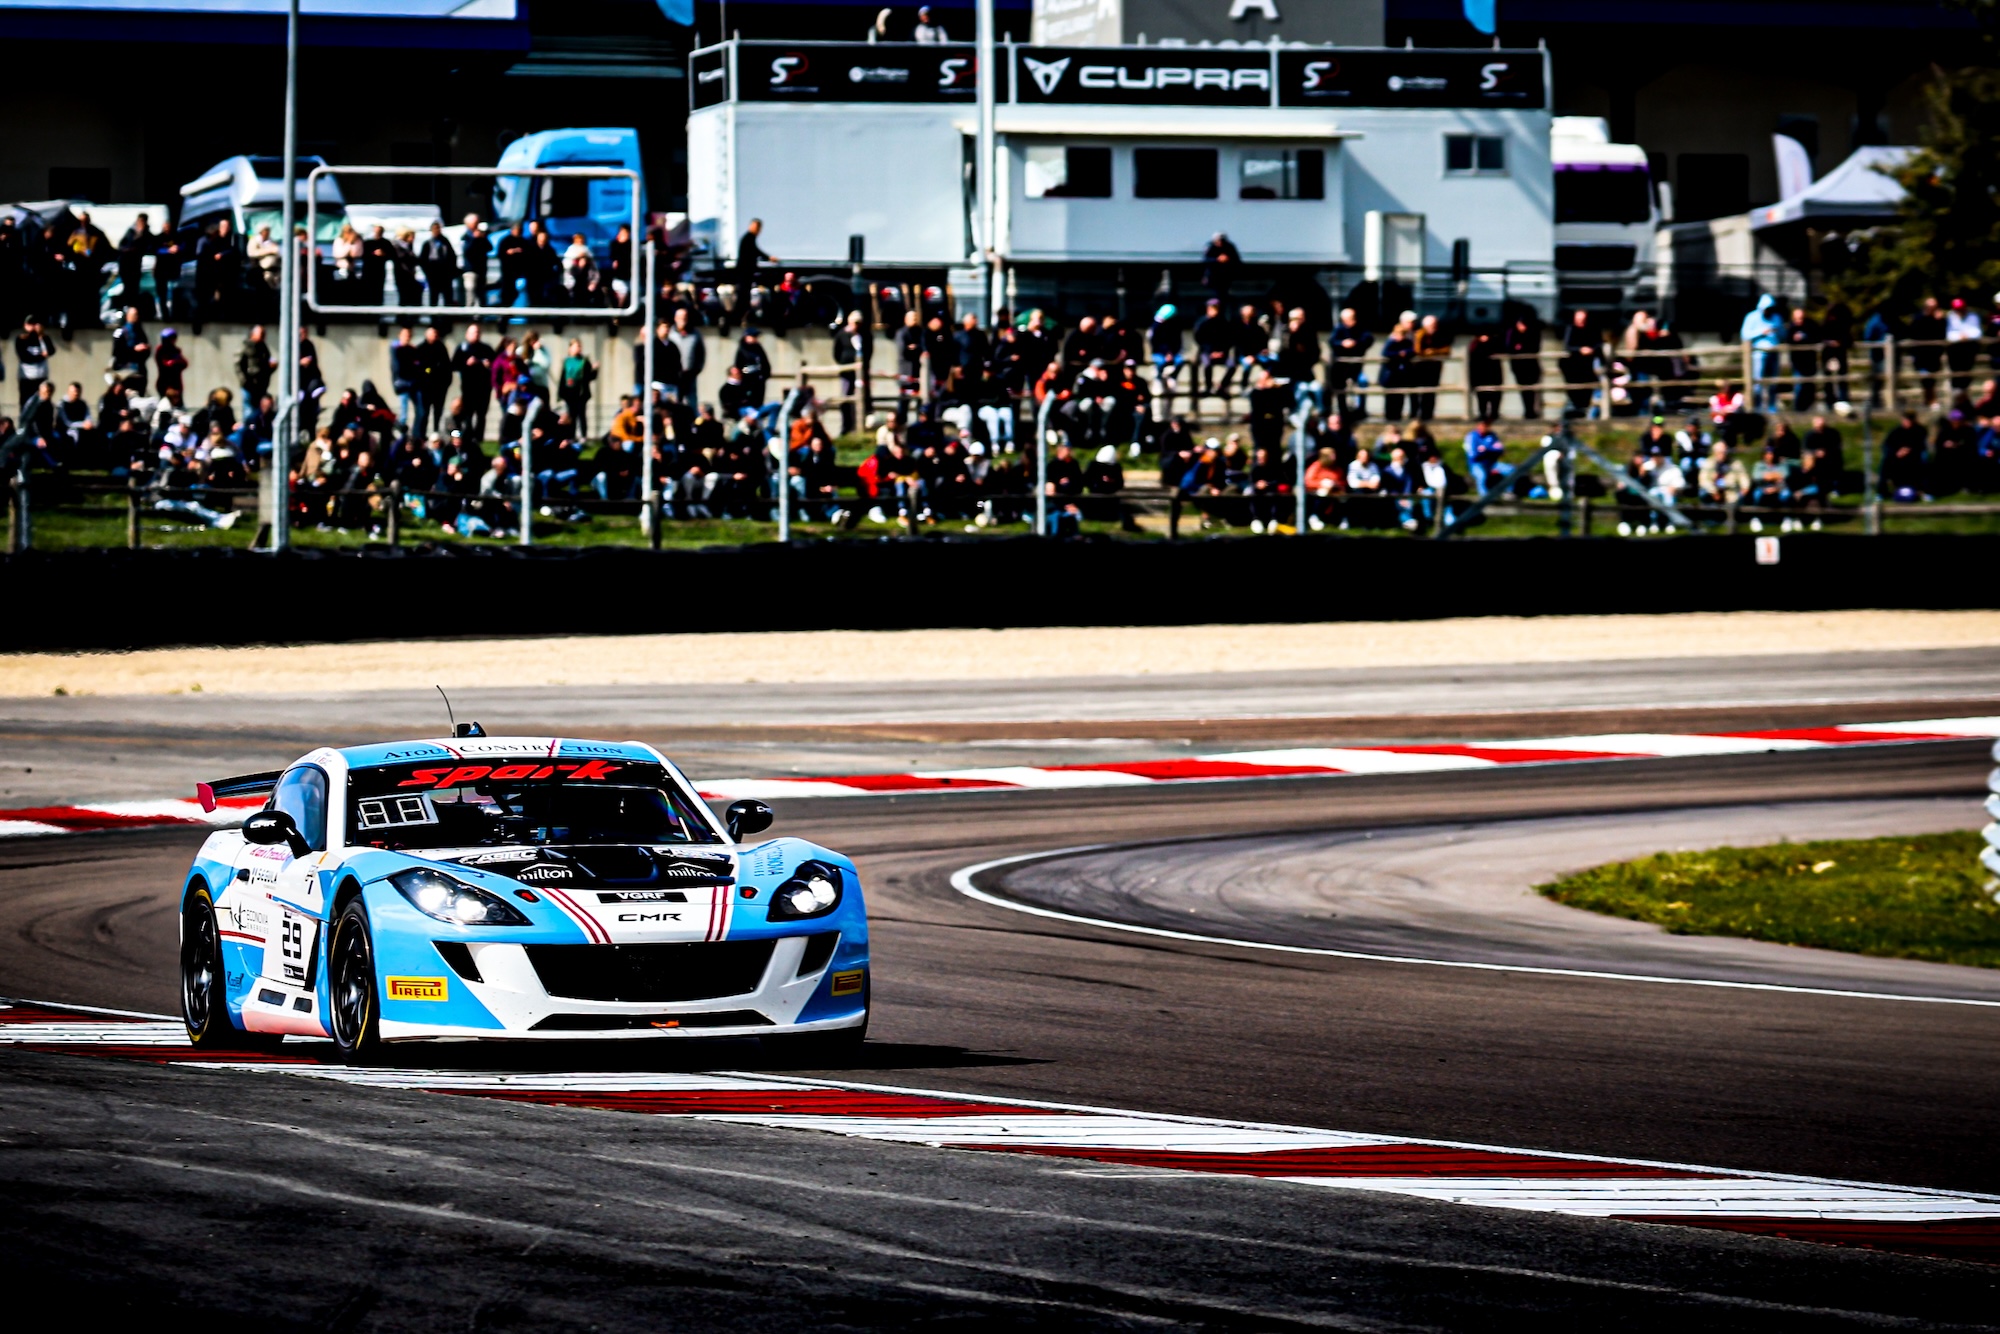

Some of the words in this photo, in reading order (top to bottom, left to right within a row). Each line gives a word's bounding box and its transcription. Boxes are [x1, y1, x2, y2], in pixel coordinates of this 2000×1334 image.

[1079, 66, 1268, 91] CUPRA
[516, 868, 573, 881] milton
[616, 892, 666, 900] VGRF
[618, 913, 683, 922] CMR
[282, 919, 302, 960] 29
[391, 980, 442, 997] PIRELLI
